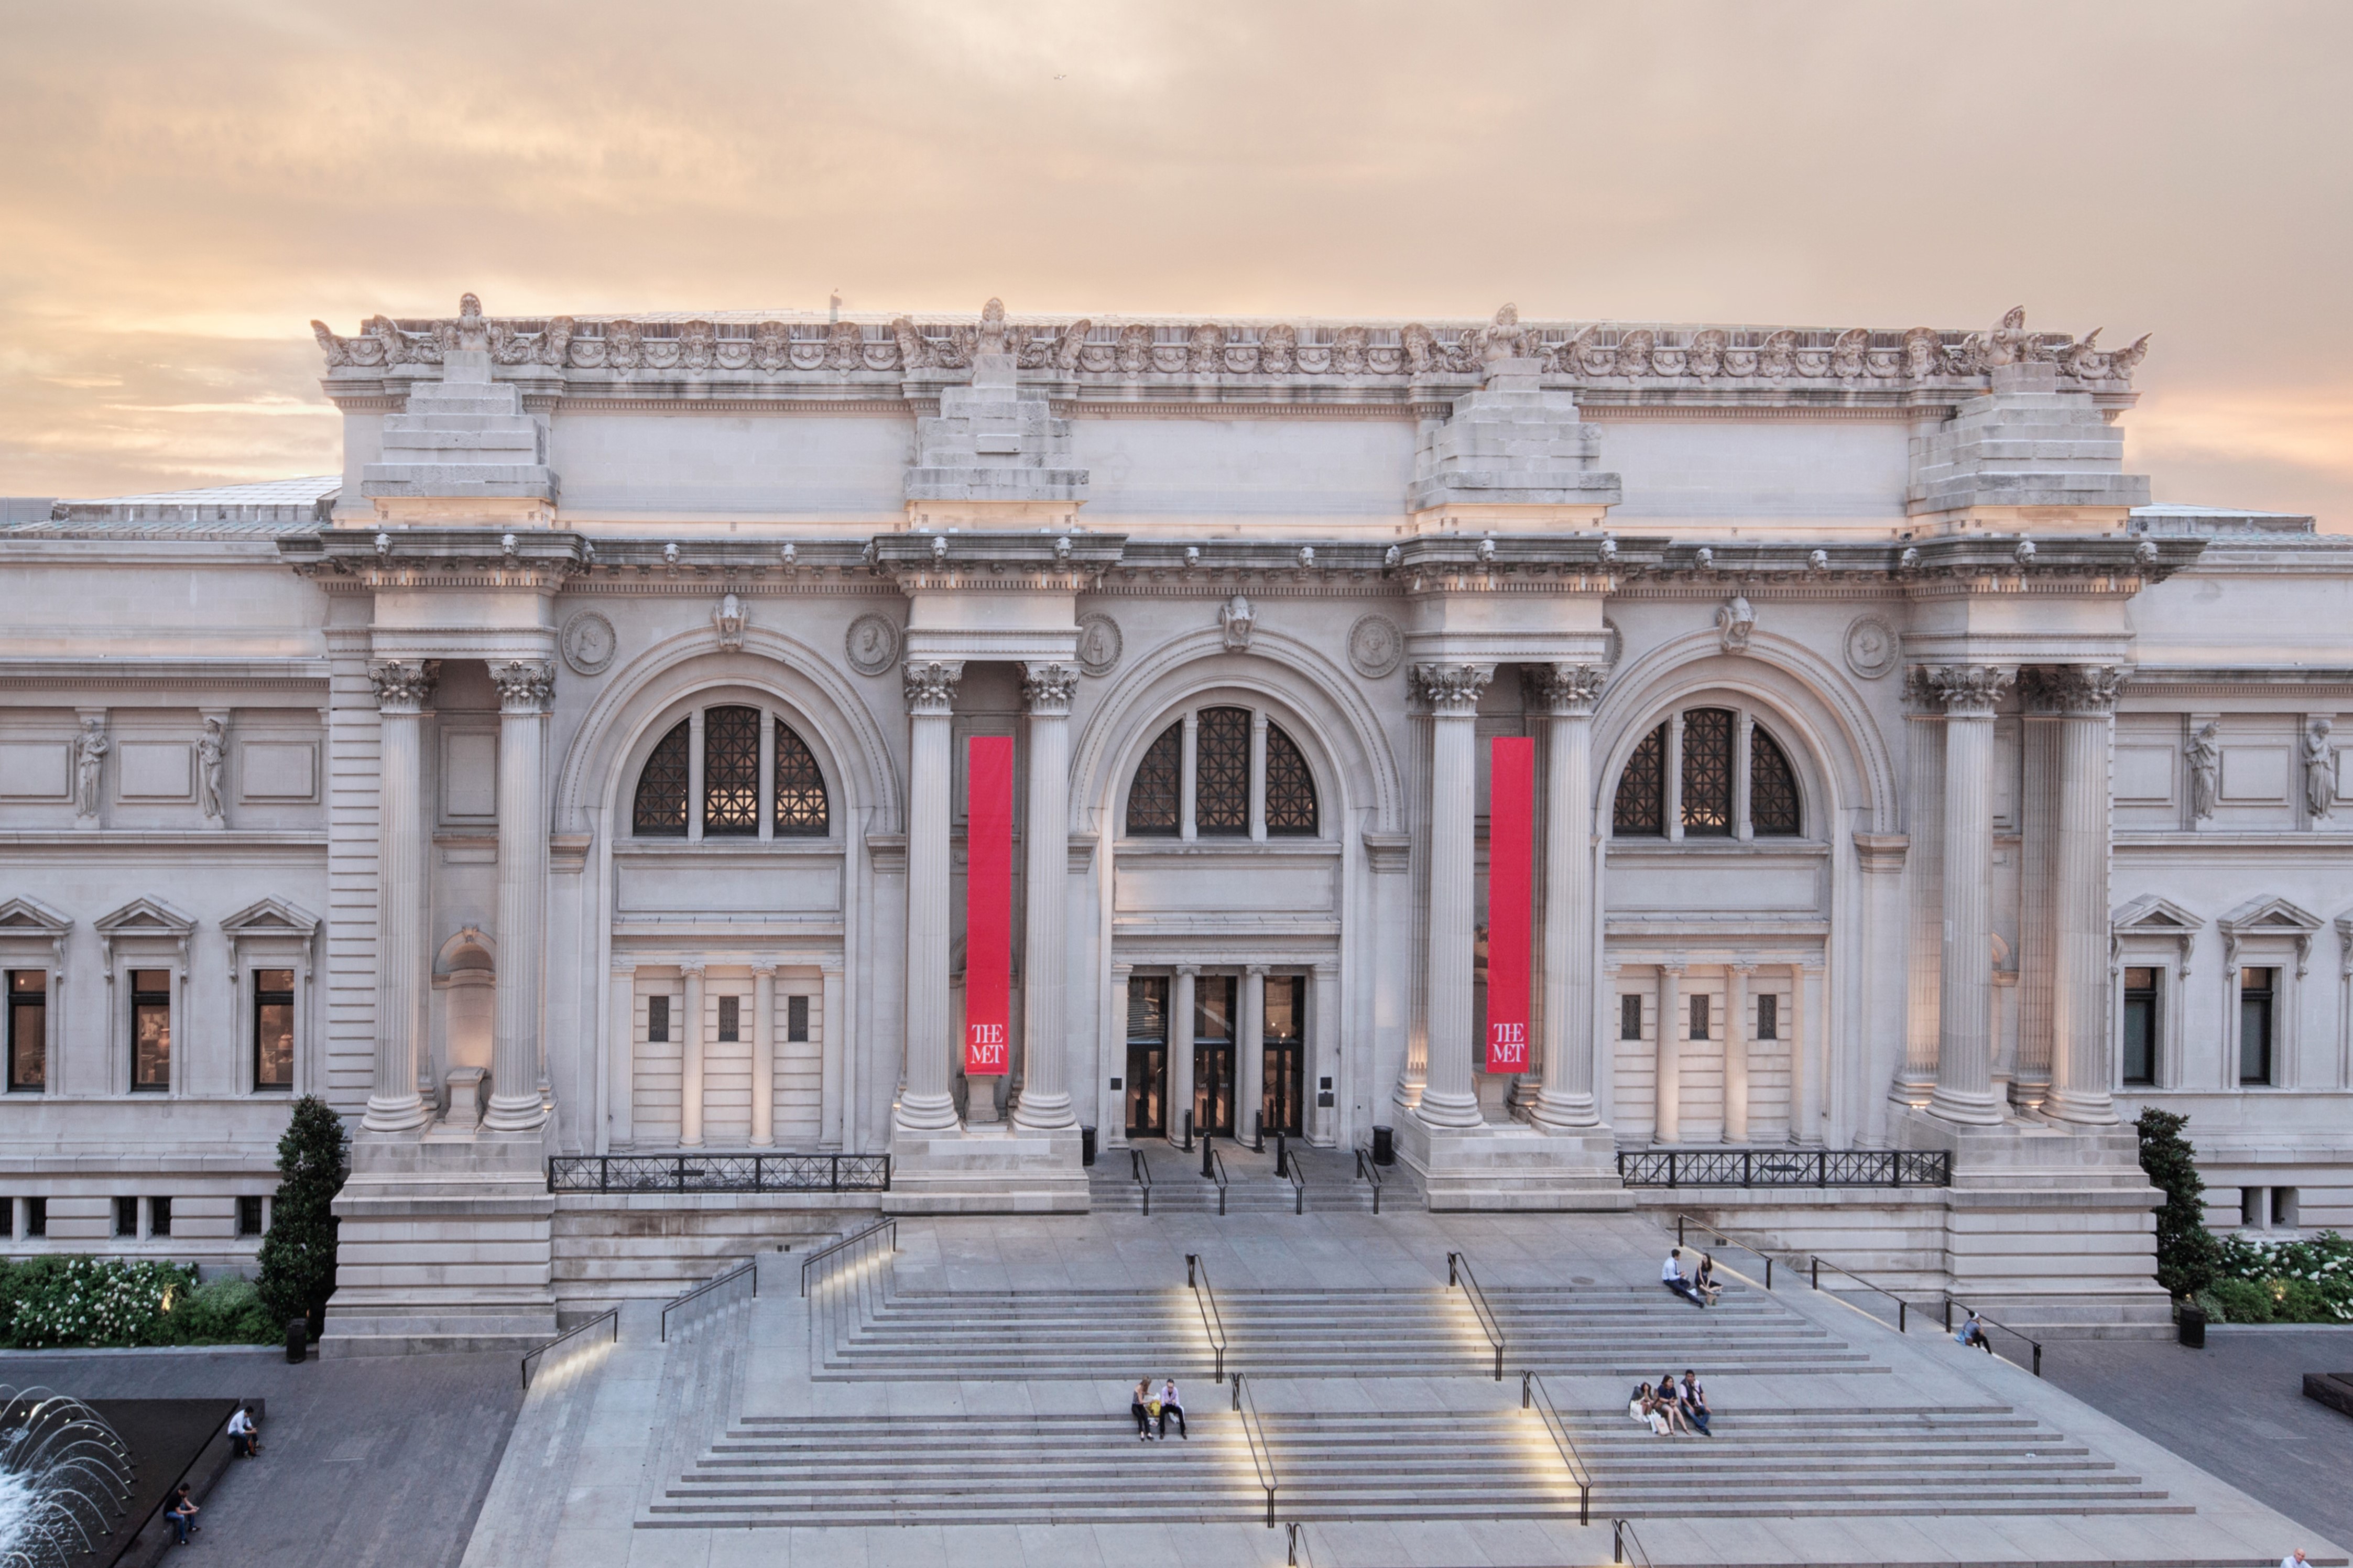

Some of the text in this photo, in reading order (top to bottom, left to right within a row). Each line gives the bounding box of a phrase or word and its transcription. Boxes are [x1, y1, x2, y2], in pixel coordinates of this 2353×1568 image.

[972, 1024, 1003, 1043] THE
[1494, 1023, 1524, 1042] THE
[971, 1044, 1004, 1063] MET
[1492, 1044, 1524, 1062] MET
